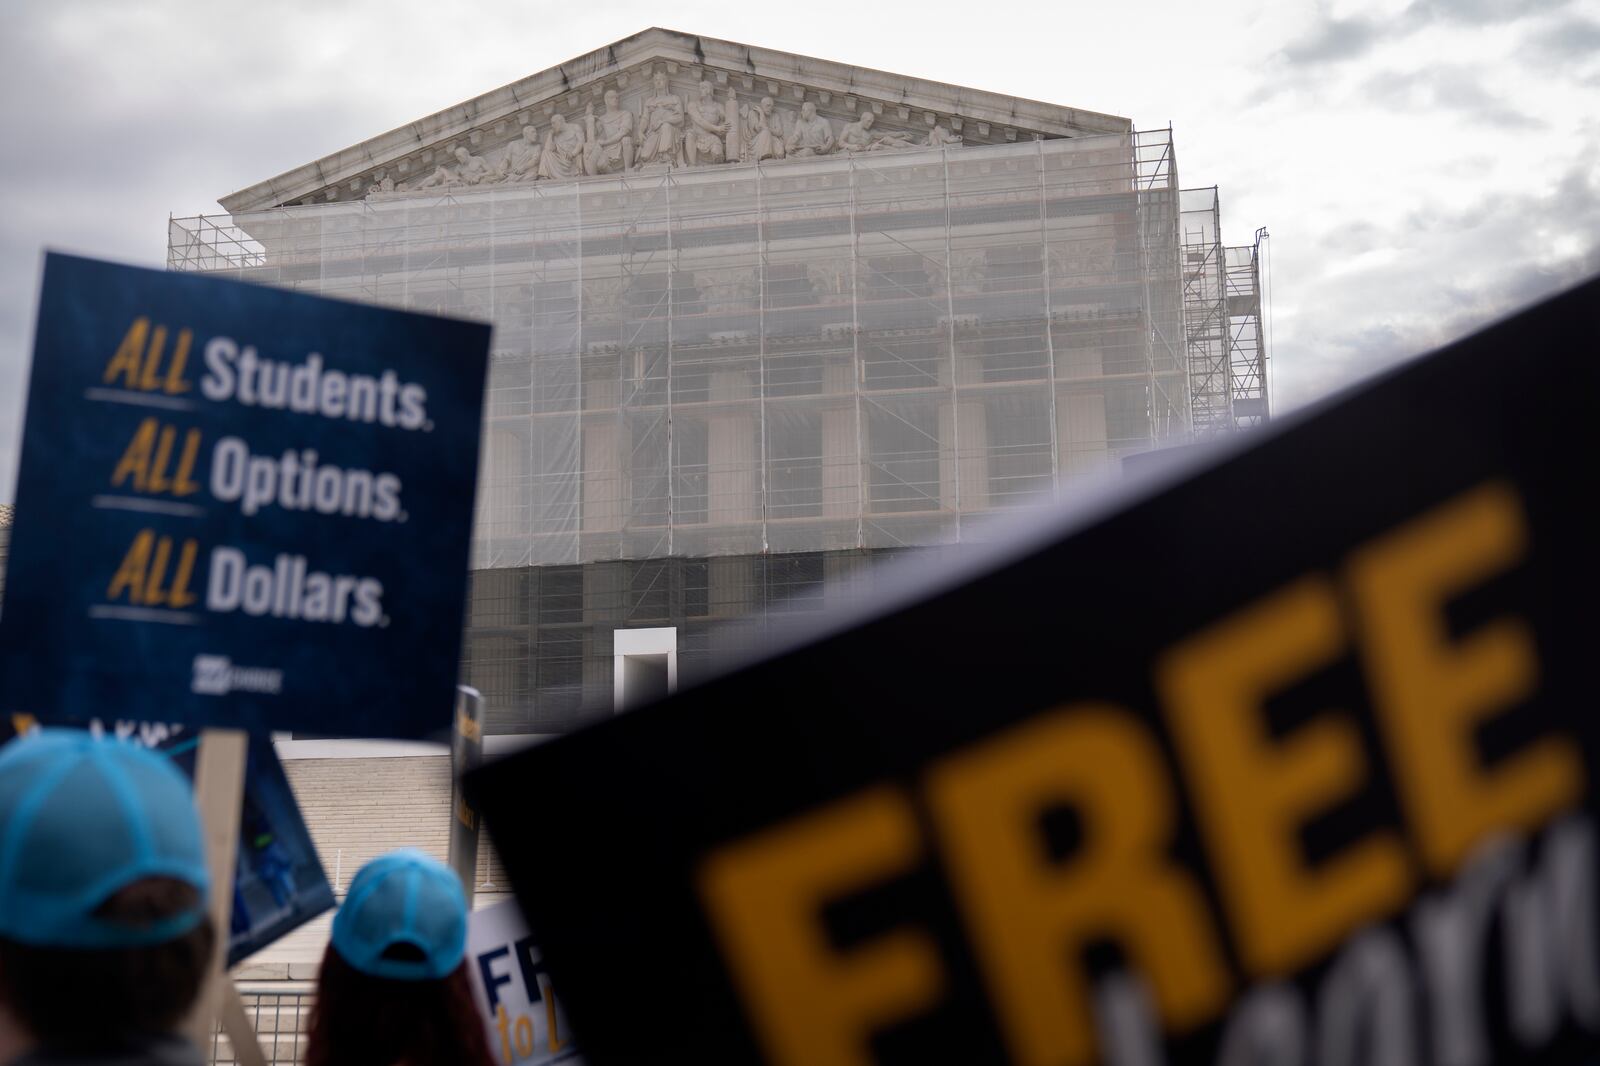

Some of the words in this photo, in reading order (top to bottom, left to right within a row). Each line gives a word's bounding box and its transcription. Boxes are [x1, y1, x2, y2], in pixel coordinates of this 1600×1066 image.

[103, 317, 192, 394] ALL
[111, 418, 200, 496] ALL
[106, 529, 198, 608] ALL
[697, 480, 1586, 1066] FREE
